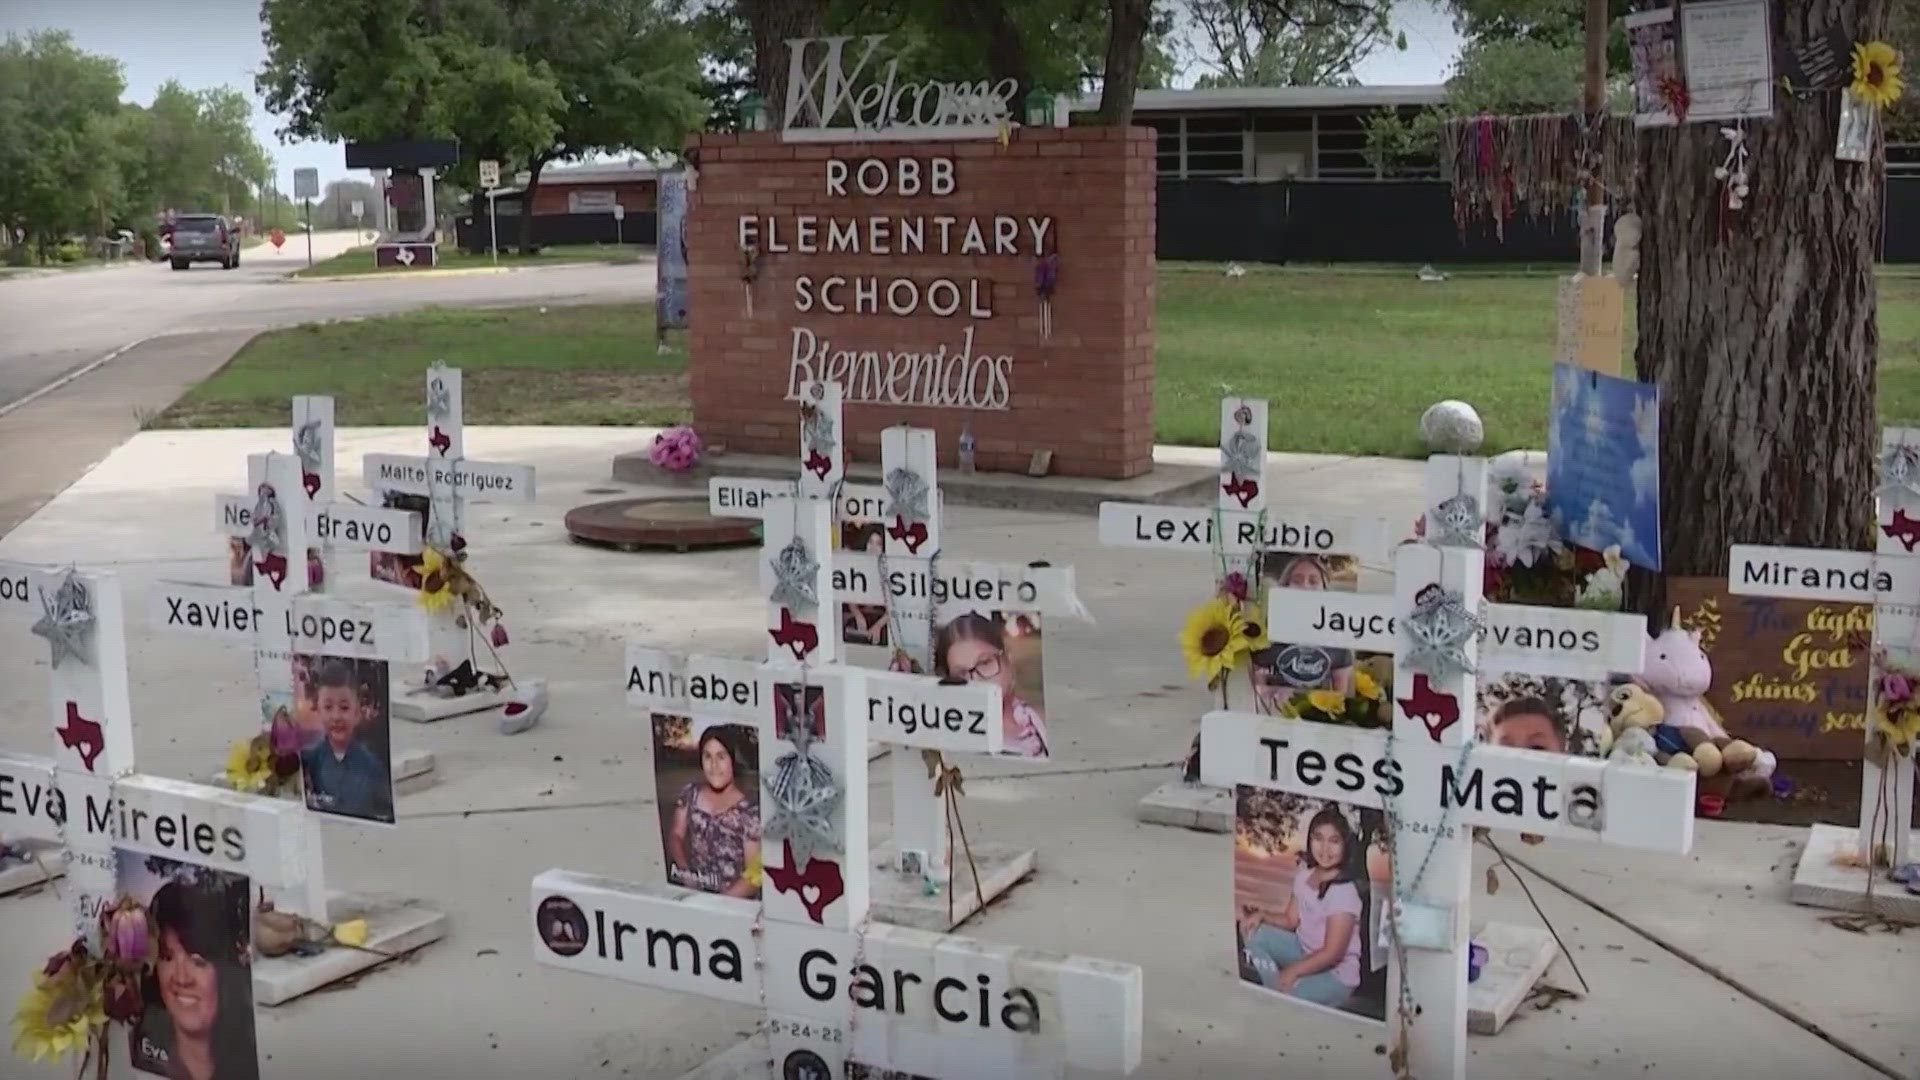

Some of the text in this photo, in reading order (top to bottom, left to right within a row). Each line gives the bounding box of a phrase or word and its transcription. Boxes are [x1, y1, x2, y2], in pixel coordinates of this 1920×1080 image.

[783, 34, 1018, 130] Welcome
[825, 156, 956, 197] ROBB
[738, 214, 1052, 256] ELEMENTARY
[793, 275, 993, 319] SCHOOL
[784, 324, 1014, 409] Bienvenidos
[317, 514, 392, 544] Bravo
[1135, 515, 1334, 550] Lexi Rubio
[889, 571, 1037, 604] Silguero
[1743, 559, 1893, 593] Miranda
[166, 596, 375, 645] Xavier Lopez
[868, 695, 987, 735] riguez
[1259, 736, 1602, 832] Tess Mata
[0, 774, 247, 863] Eva Mireles
[594, 908, 1041, 1035] Irma Garcia
[141, 1036, 169, 1063] Eva
[770, 1019, 844, 1043] 5-24-22
